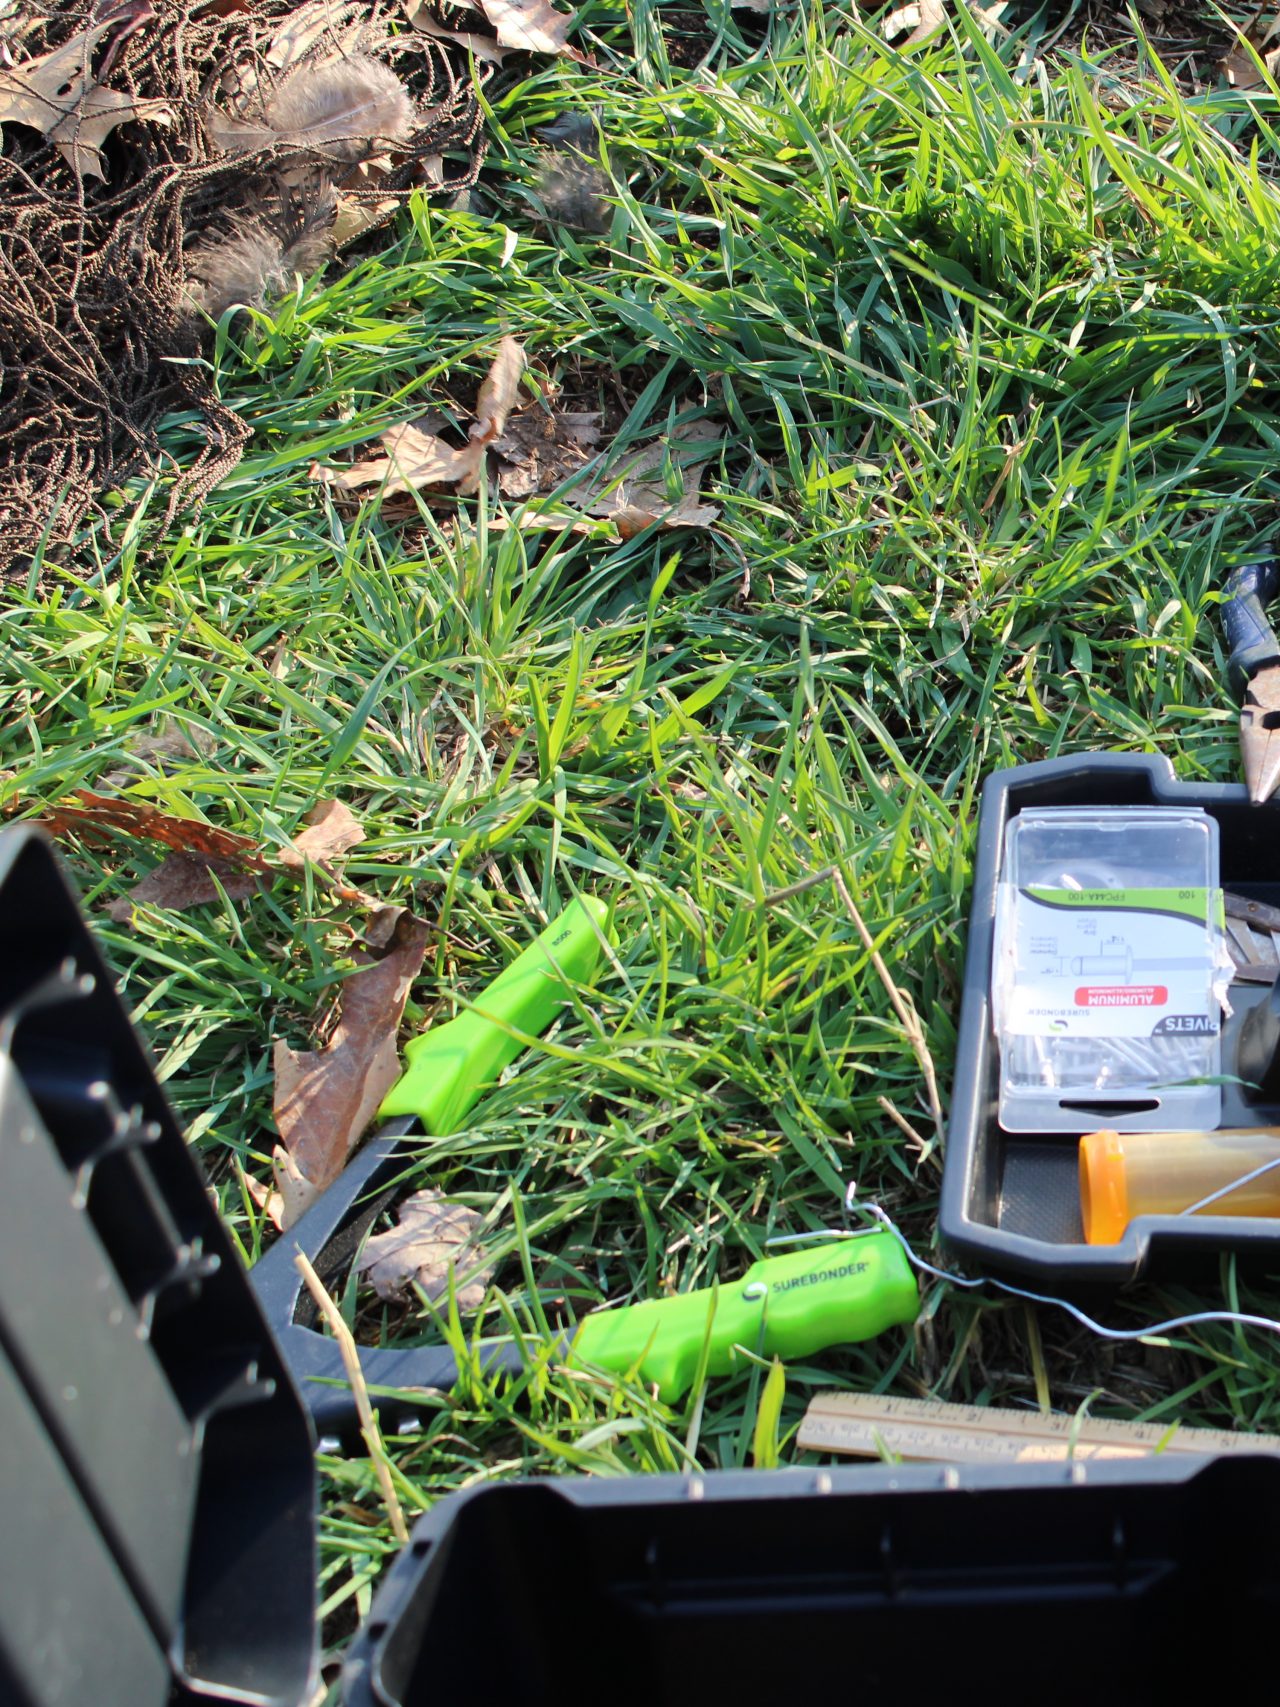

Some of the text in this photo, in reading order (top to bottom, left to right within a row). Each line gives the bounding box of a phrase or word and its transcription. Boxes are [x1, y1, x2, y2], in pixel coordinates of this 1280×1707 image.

[1178, 890, 1195, 900] 100
[1088, 994, 1154, 1005] ALUMINUM
[1027, 1008, 1091, 1017] SUREBONDER
[772, 1263, 867, 1293] SUREBONDER
